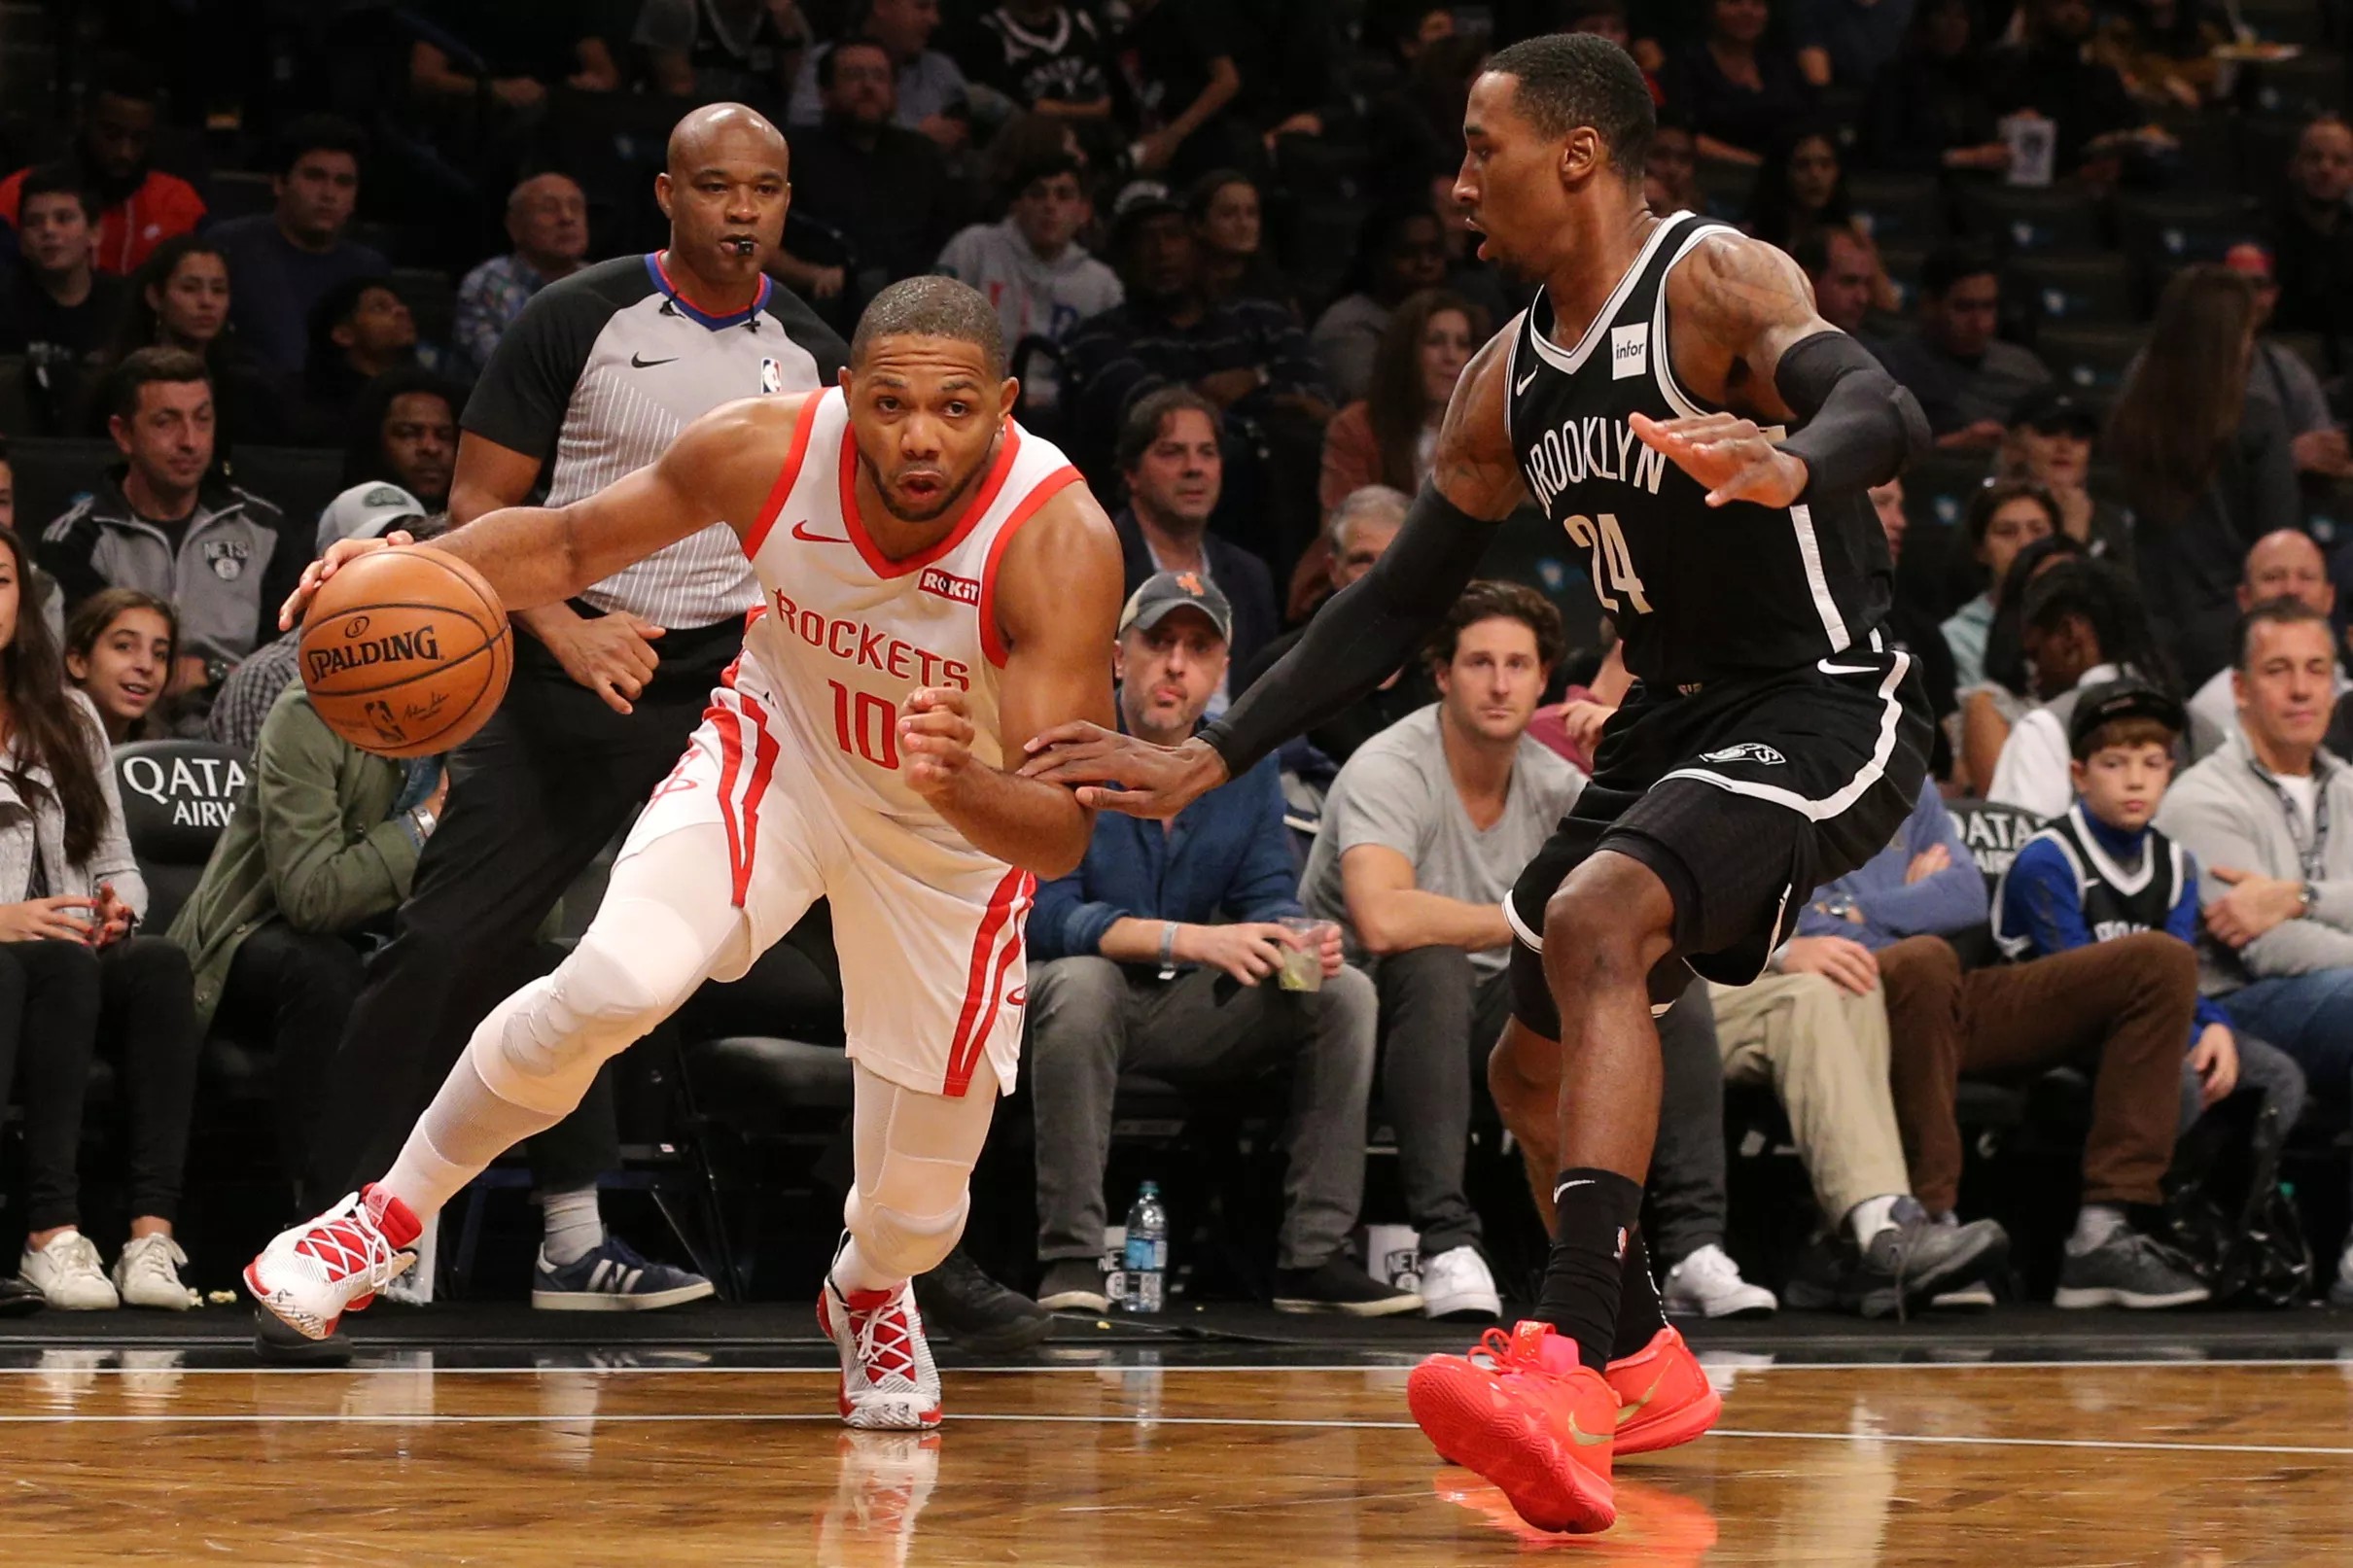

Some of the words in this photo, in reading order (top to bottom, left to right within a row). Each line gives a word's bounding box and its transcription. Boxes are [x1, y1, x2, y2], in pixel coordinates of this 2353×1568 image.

[1616, 340, 1644, 360] infor
[1563, 513, 1653, 614] 24
[307, 625, 439, 684] SPALDING
[772, 588, 969, 692] ROCKETS
[827, 679, 899, 770] 10
[1947, 810, 2046, 849] ATA
